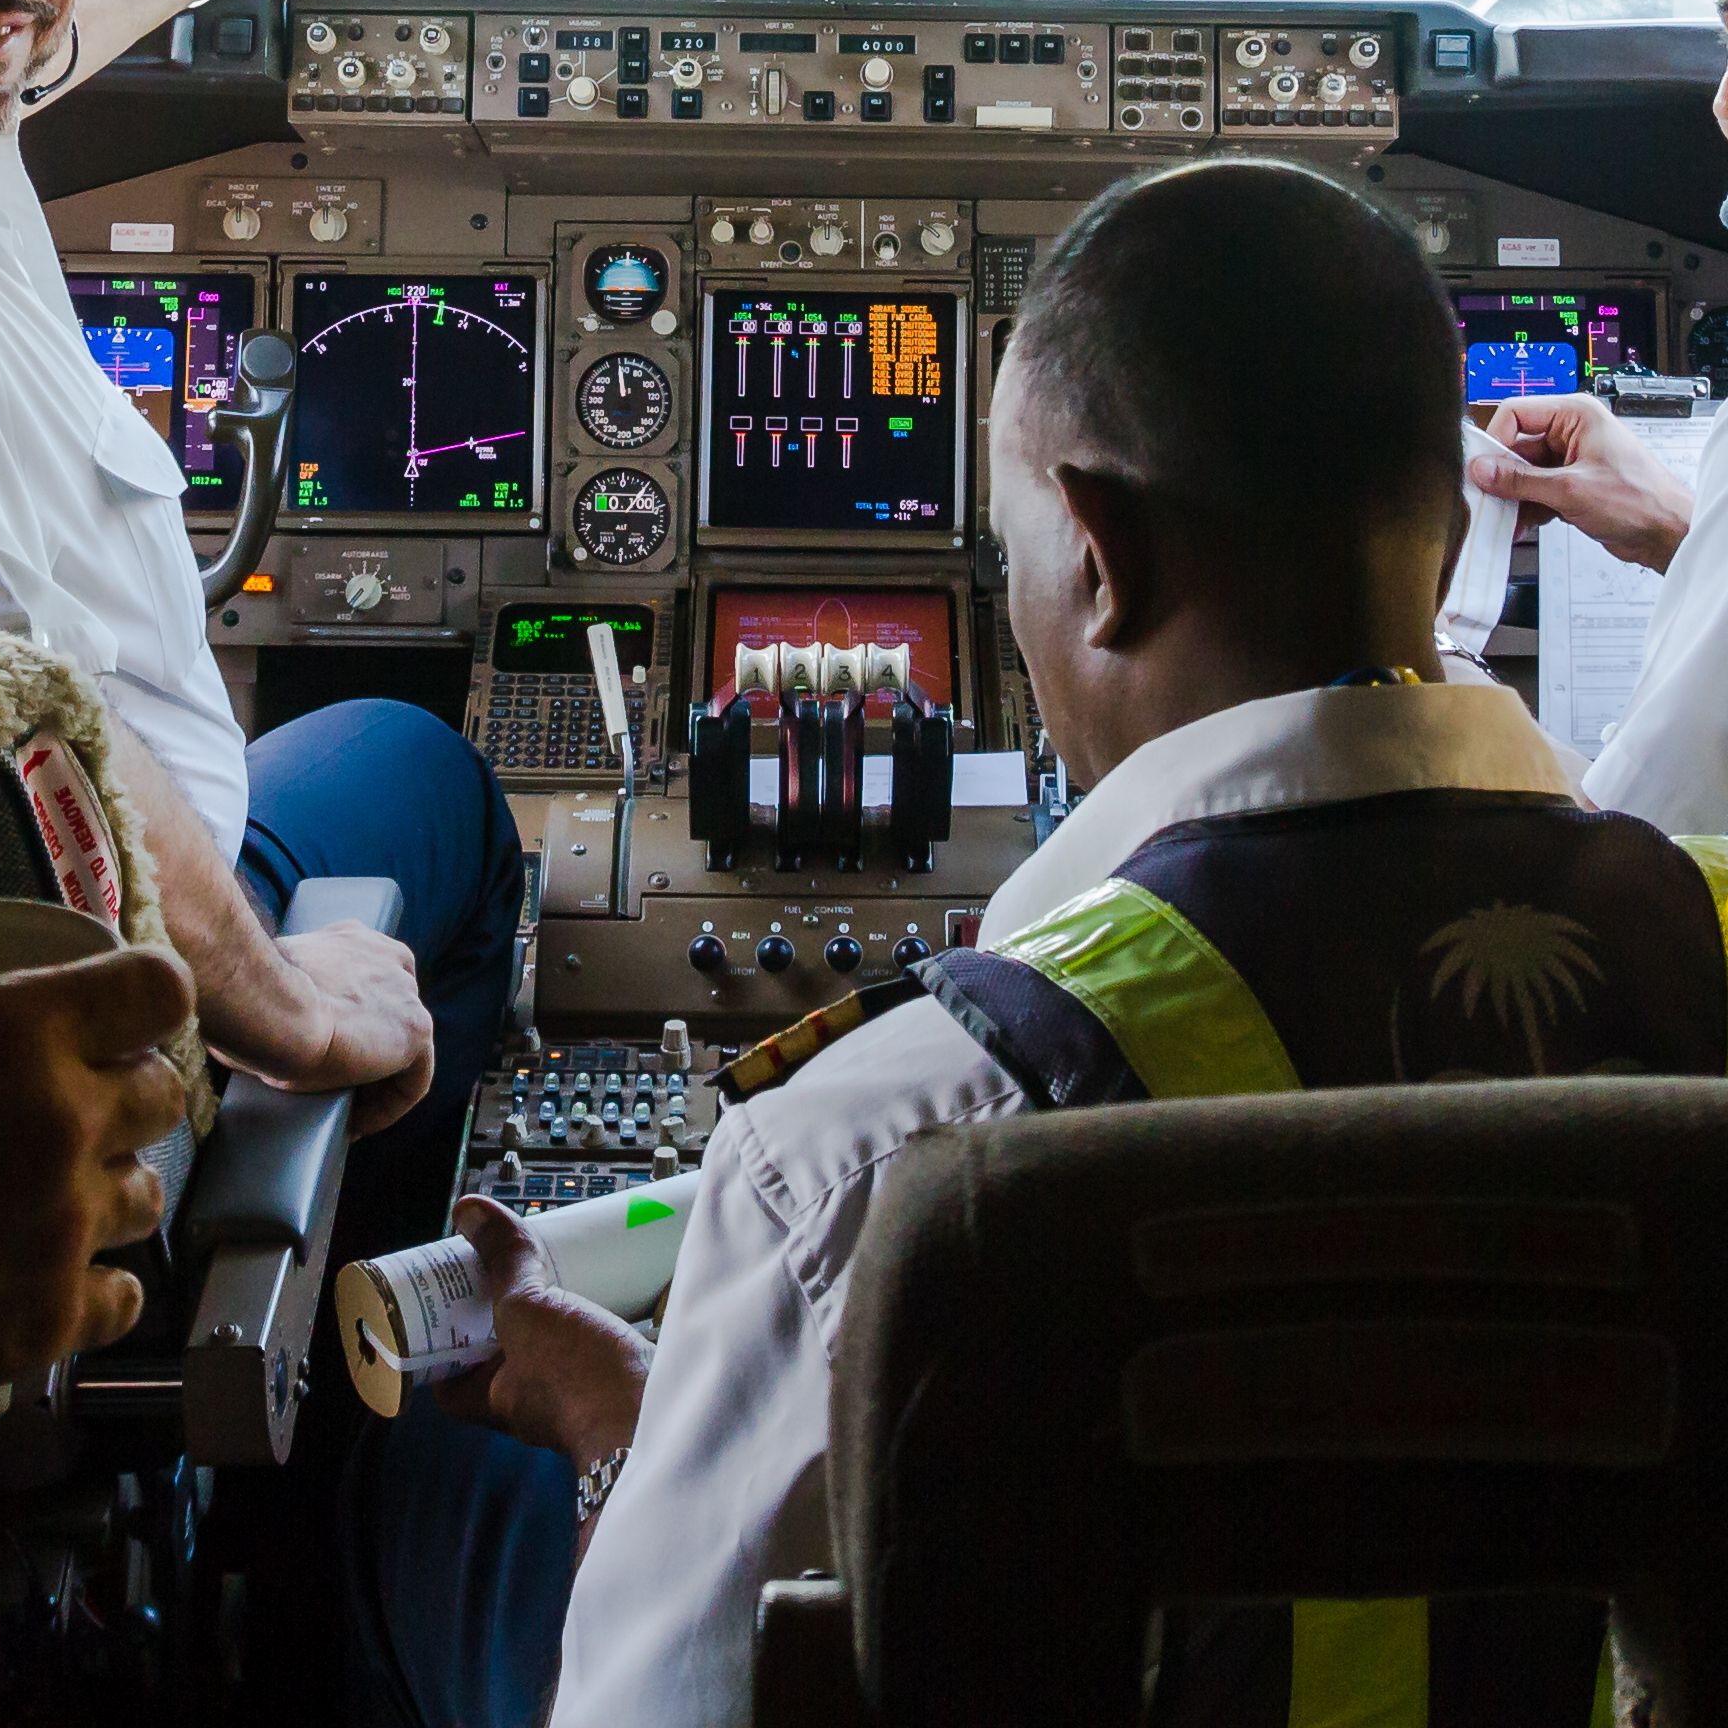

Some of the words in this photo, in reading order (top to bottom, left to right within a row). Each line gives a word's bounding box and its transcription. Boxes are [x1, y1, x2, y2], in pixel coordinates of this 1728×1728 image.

[572, 36, 601, 47] 158
[674, 38, 704, 49] 220
[862, 41, 904, 52] 6000
[1501, 243, 1522, 251] ACAS
[319, 282, 327, 292] 0
[407, 285, 426, 296] 220
[430, 287, 445, 296] MAG
[494, 283, 508, 291] KAT
[787, 302, 797, 311] TO
[900, 305, 928, 313] SOURCE
[113, 316, 127, 327] FD
[384, 314, 393, 323] 21
[909, 313, 933, 322] CARGO
[457, 319, 469, 330] 24
[900, 322, 936, 330] SHUTDOWN
[1515, 331, 1528, 342] FD
[900, 338, 936, 346] SHUTDOWN
[900, 346, 936, 354] SHUTDOWN
[900, 354, 922, 362] ENTRY
[926, 354, 932, 363] L
[872, 362, 892, 370] FUEL
[926, 362, 940, 370] AFT
[872, 371, 892, 379] FUEL
[926, 371, 941, 379] FWD
[402, 377, 412, 387] 20
[872, 379, 892, 387] FUEL
[926, 379, 940, 387] AFT
[590, 385, 606, 393] 350
[872, 387, 892, 395] FUEL
[926, 387, 941, 395] FWD
[646, 405, 660, 413] 140
[299, 481, 314, 489] VOR
[494, 483, 509, 491] VOR
[299, 489, 314, 497] KAT
[494, 491, 508, 499] KAT
[314, 497, 328, 506] 1.5
[509, 498, 524, 507] 1.5
[875, 502, 890, 510] FUEL
[585, 523, 592, 531] 7
[615, 523, 628, 531] ALT
[651, 524, 658, 533] 3
[341, 550, 389, 559] AUTOBRAKES
[390, 593, 411, 601] AUTO
[752, 666, 761, 683] 1
[794, 663, 806, 680] 2
[839, 665, 851, 682] 3
[881, 664, 893, 681] 4
[53, 785, 98, 854] REMOVE
[89, 856, 108, 881] TO
[784, 905, 802, 914] FUEL
[813, 906, 854, 915] CONTROL
[731, 931, 751, 940] RUN
[868, 933, 888, 941] RUN
